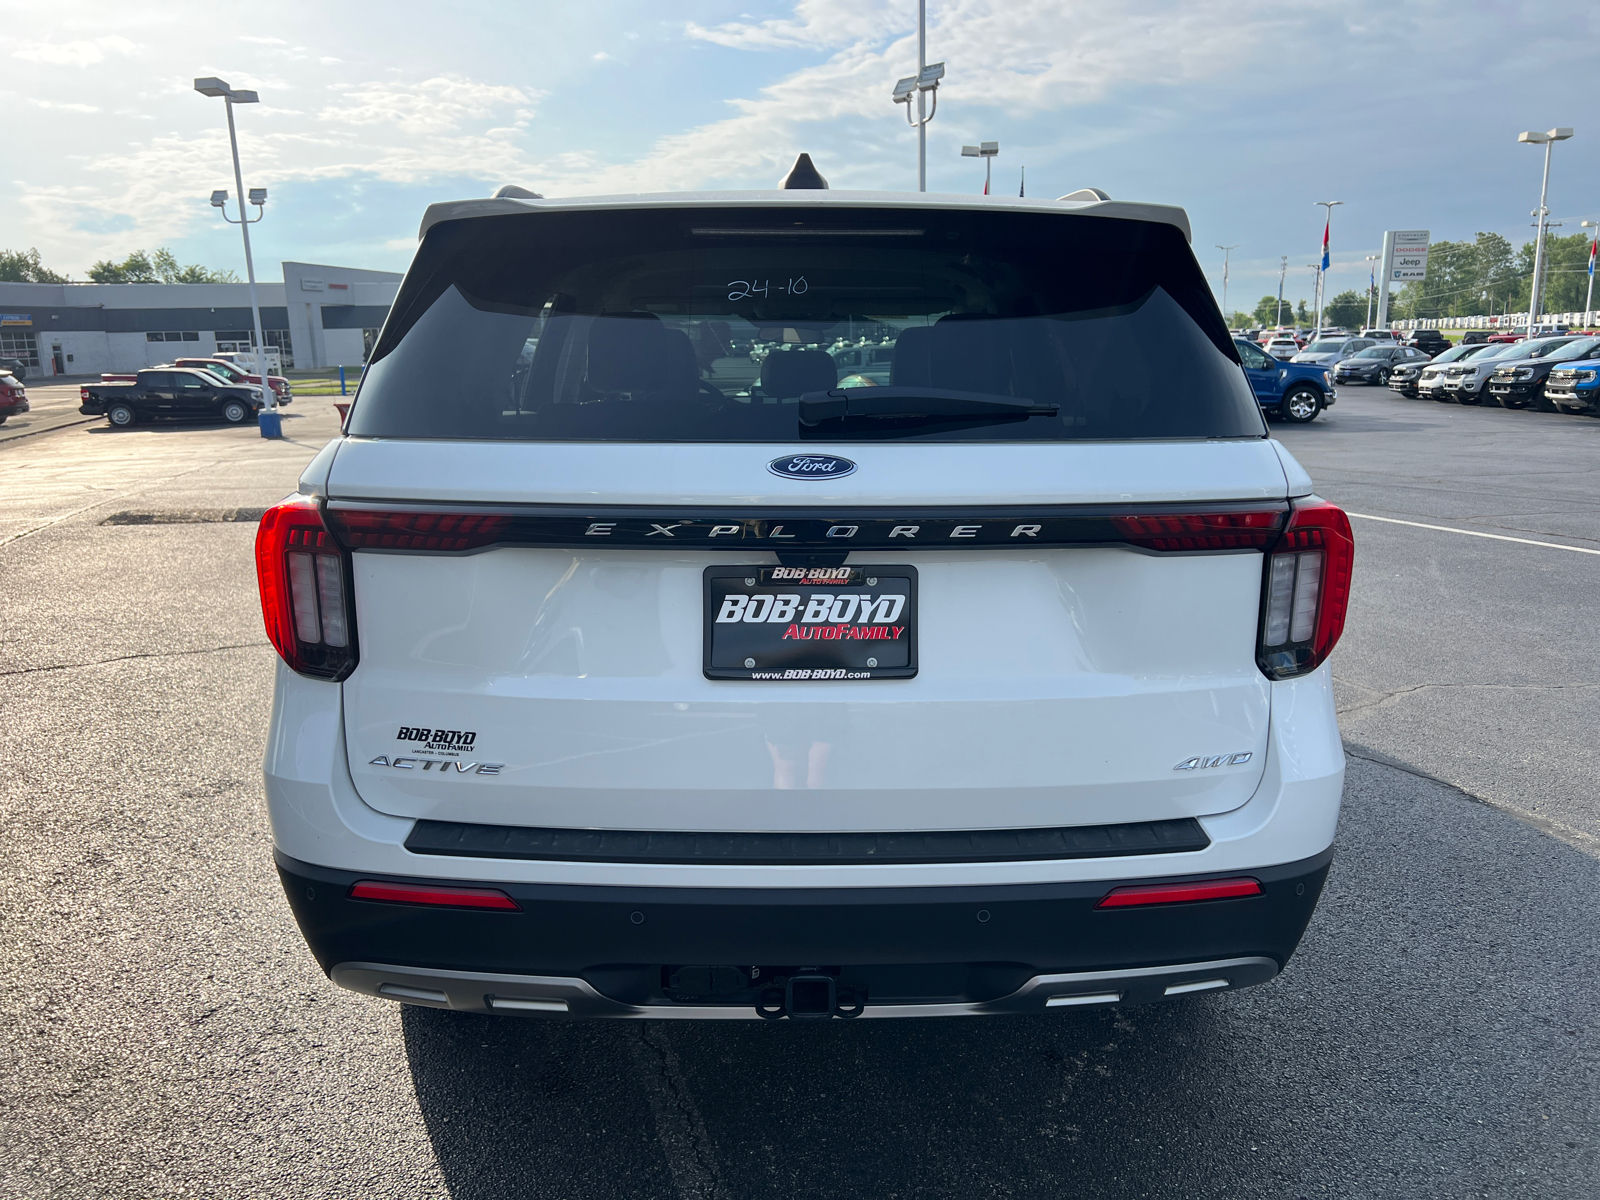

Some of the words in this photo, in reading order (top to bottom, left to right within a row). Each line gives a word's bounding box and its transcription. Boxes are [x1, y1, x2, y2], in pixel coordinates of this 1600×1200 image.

[1400, 258, 1420, 266] Jeep
[727, 276, 808, 301] 24-10
[788, 456, 837, 472] Ford
[584, 522, 1042, 539] EXPLORER
[771, 567, 852, 579] BOB-BOYD
[715, 594, 906, 624] BOB-BOYD
[752, 669, 871, 680] www.BOB-BOYD.com
[396, 726, 477, 745] BOB-BOYD
[368, 754, 506, 776] ACTIVE
[1173, 751, 1253, 770] 4WD
